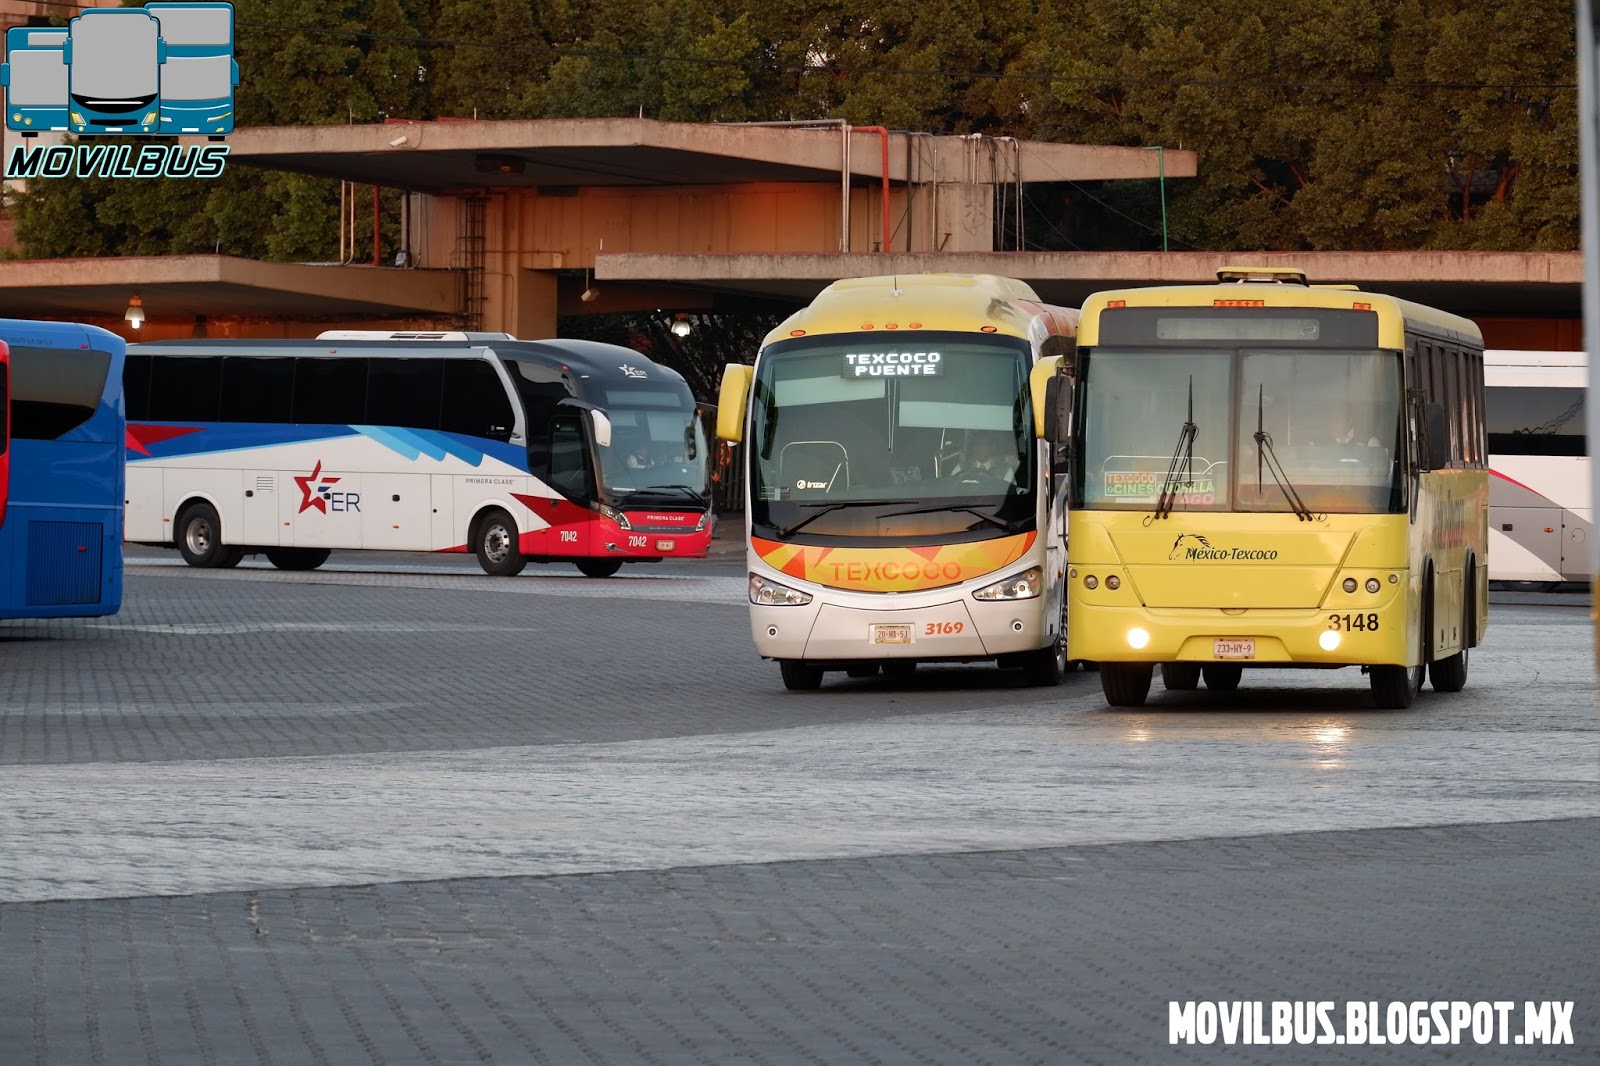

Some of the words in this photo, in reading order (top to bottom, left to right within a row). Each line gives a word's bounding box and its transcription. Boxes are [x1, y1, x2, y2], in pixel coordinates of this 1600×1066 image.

[845, 352, 941, 365] TEXCOCO
[855, 364, 936, 377] PUENTE
[1106, 473, 1155, 483] TEXCOCO
[331, 492, 361, 512] ER
[560, 531, 577, 542] 7042
[628, 536, 647, 547] 7042
[1185, 546, 1278, 562] México-Texcoco
[828, 561, 962, 581] TEXCOCO
[924, 621, 964, 635] 3169
[1328, 613, 1379, 632] 3148
[1217, 643, 1252, 654] 233-HY-9
